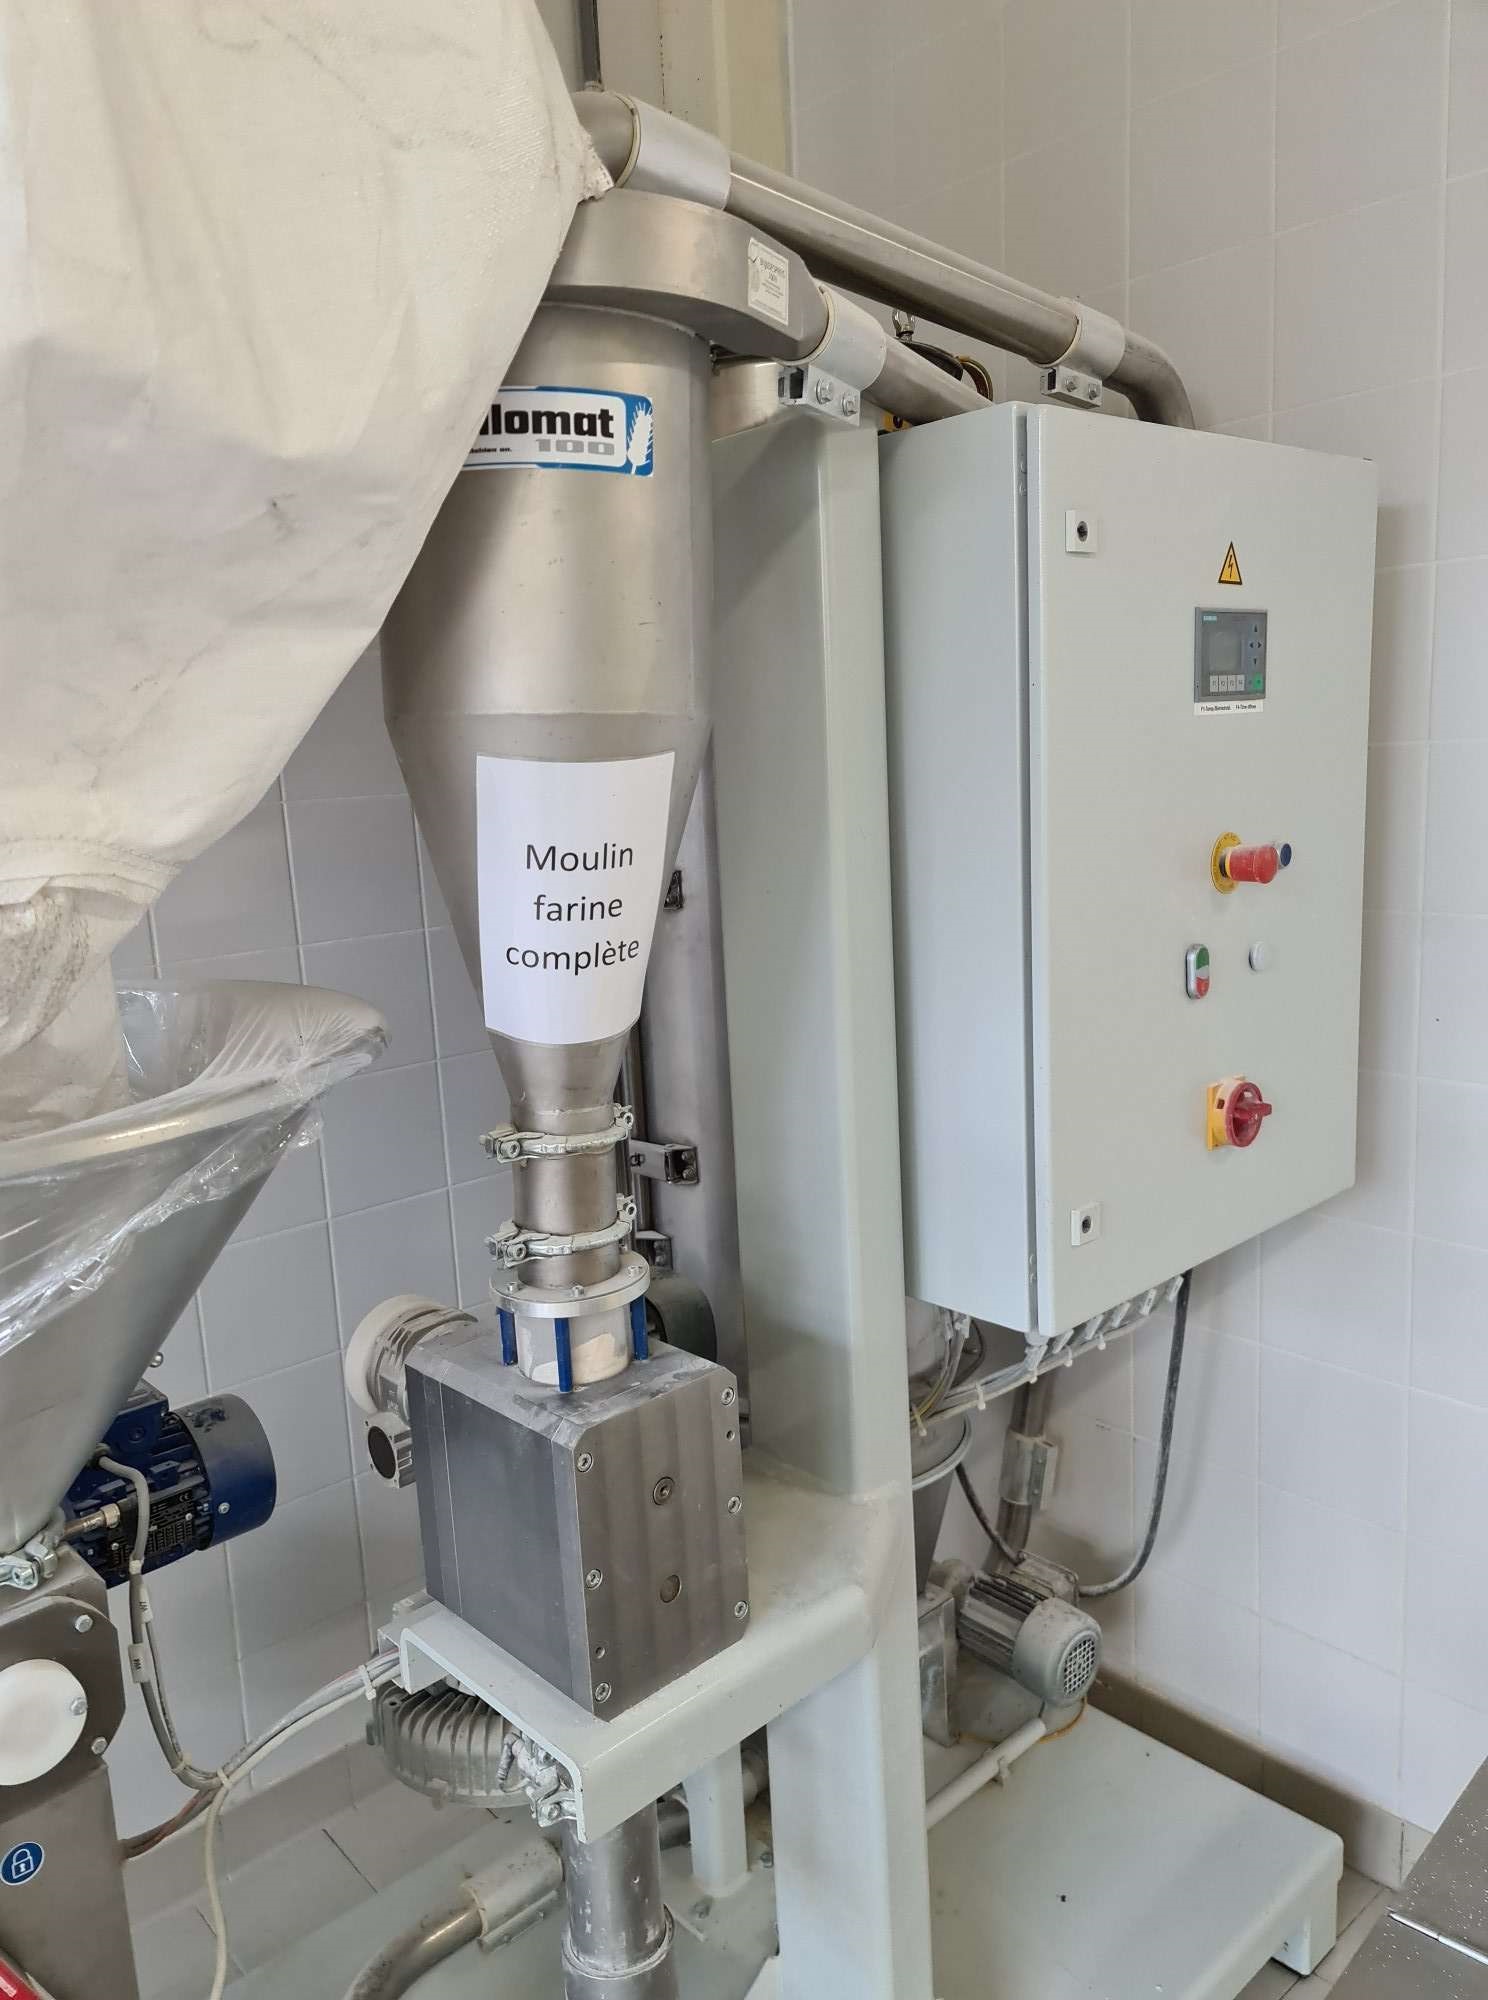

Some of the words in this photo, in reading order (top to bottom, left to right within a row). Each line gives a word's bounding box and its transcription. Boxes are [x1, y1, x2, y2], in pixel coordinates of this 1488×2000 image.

[536, 439, 615, 456] 100
[526, 843, 634, 872] Moulin
[534, 894, 624, 922] farine
[506, 940, 641, 976] complète
